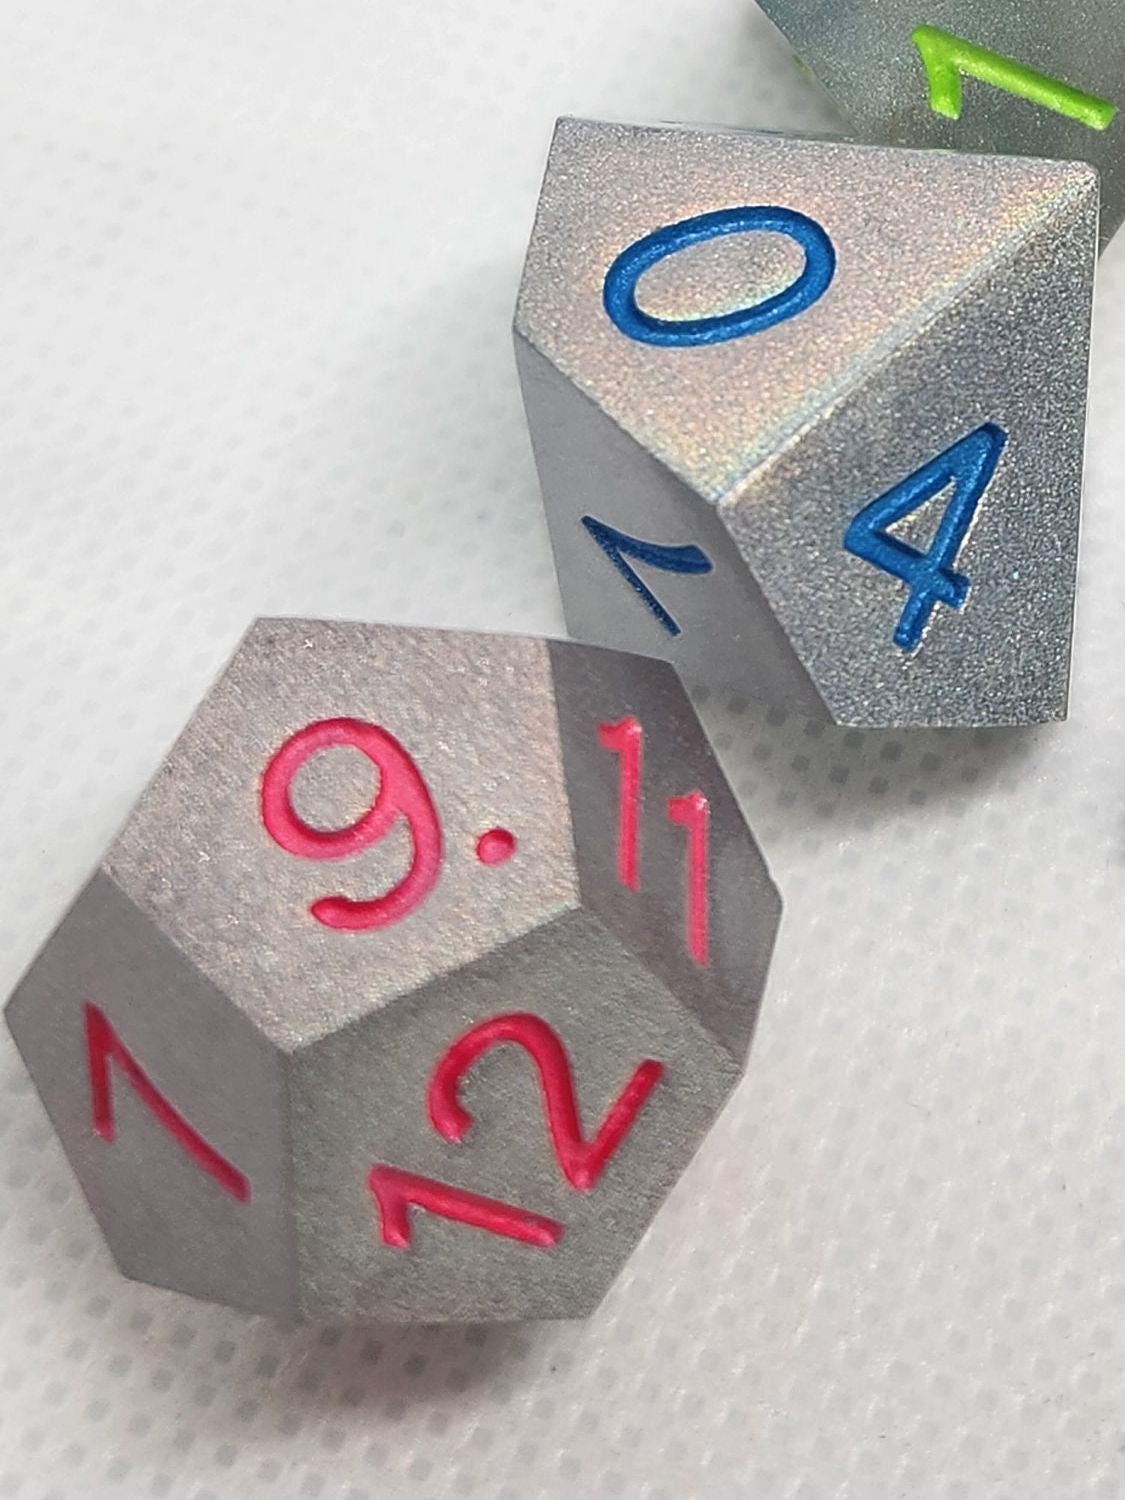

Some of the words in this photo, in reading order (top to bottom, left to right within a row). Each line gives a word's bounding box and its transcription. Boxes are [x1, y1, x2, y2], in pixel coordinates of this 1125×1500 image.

[910, 23, 1117, 130] 1
[603, 205, 836, 348] 0
[842, 421, 1009, 654] 4
[597, 715, 710, 967] 11
[366, 1011, 666, 1250] 12
